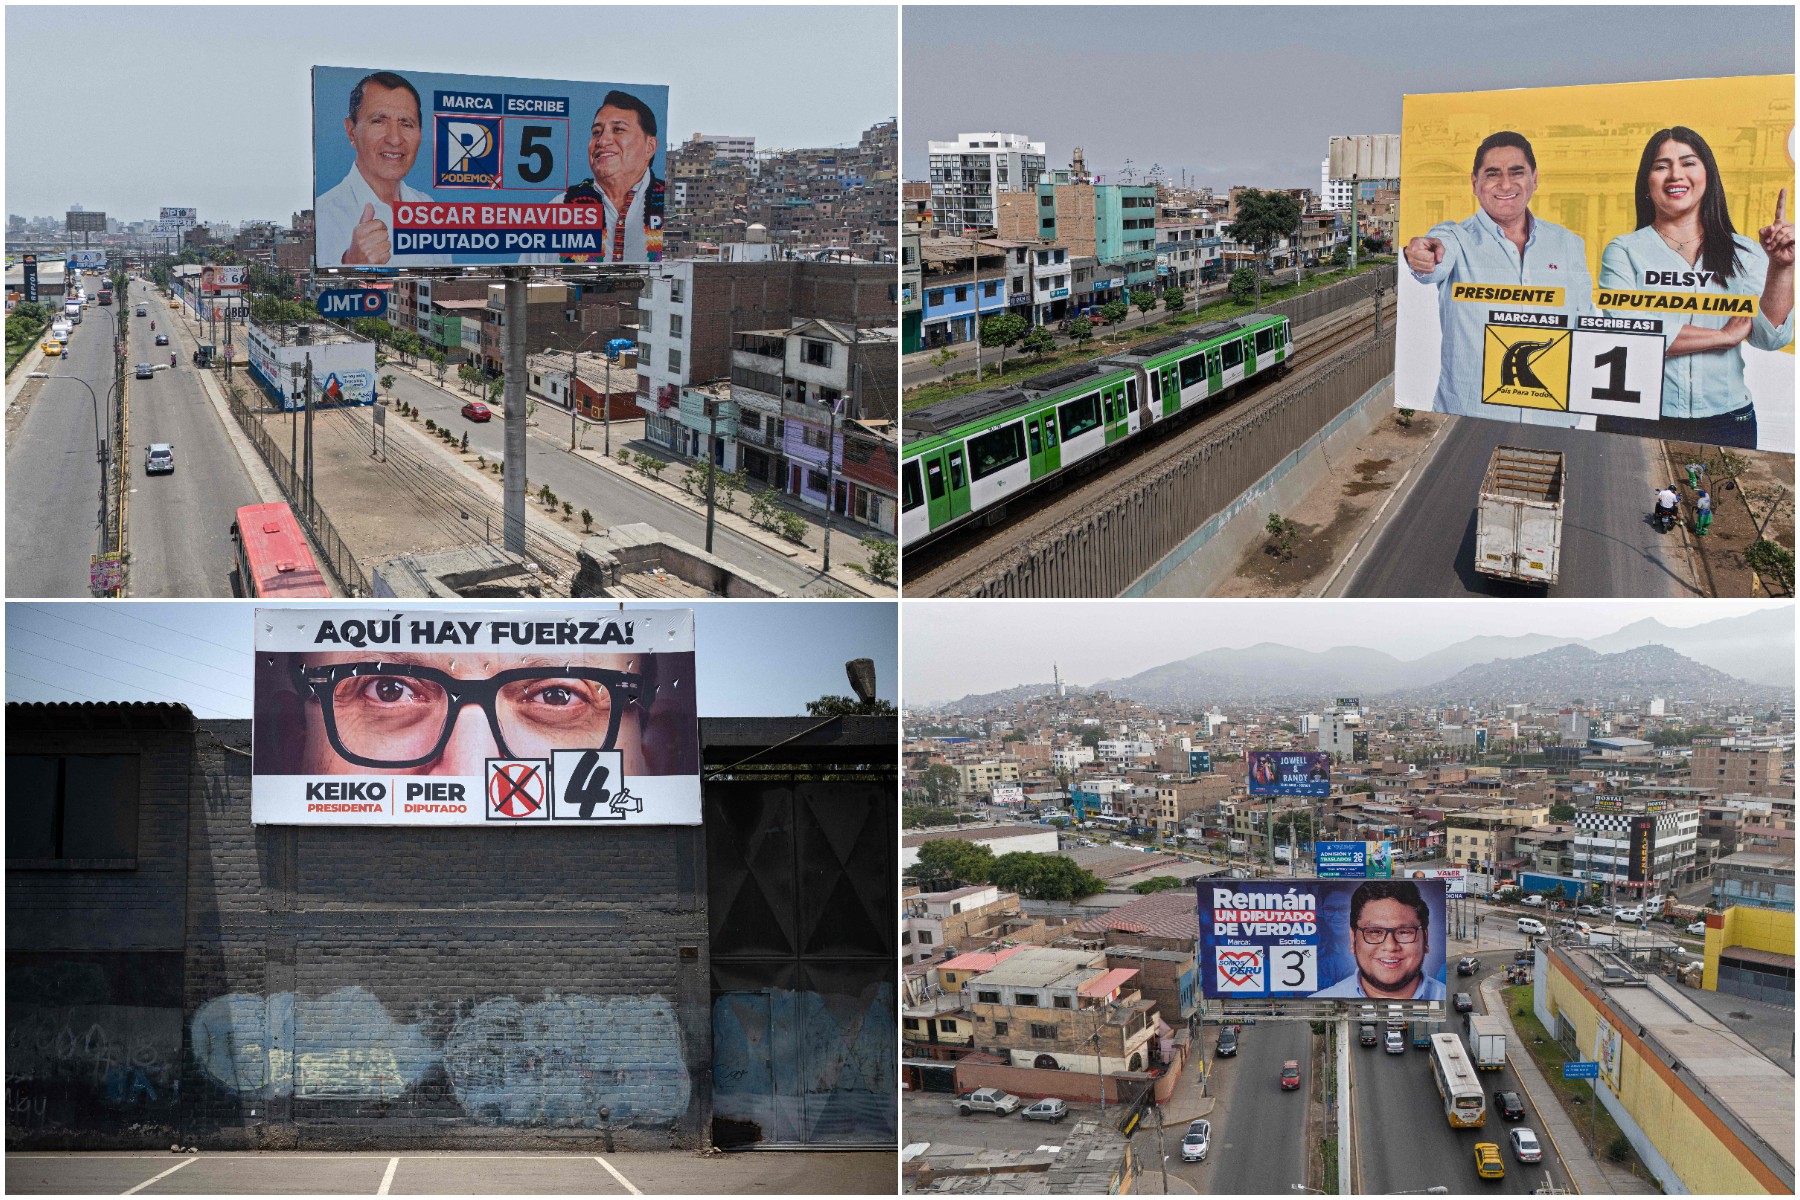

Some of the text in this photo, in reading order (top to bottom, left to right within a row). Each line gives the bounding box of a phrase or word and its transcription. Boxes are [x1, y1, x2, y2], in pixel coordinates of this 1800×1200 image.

[442, 95, 493, 109] MARCA
[508, 98, 565, 113] ESCRIBE
[517, 126, 553, 184] 5
[441, 173, 495, 184] PODEMOS
[398, 205, 597, 226] OSCAR BENAVIDES
[398, 232, 596, 250] DIPUTADO POR LIMA
[231, 274, 239, 283] 6
[1645, 271, 1712, 287] DELSY
[1454, 286, 1555, 303] PRESIDENTE
[1598, 293, 1755, 314] DIPUTADA LIMA
[1494, 312, 1559, 325] MARCA ASI
[1580, 318, 1655, 331] ESCRIBE ASI
[1590, 346, 1641, 404] 1
[314, 614, 635, 648] AQUÍ HAY FUERZA!
[1280, 756, 1308, 765] JOWELL
[1293, 765, 1299, 773] &
[563, 750, 611, 818] 4
[1283, 774, 1308, 782] RANDY
[306, 782, 387, 801] KEIKO
[406, 783, 466, 801] PIER
[307, 803, 382, 813] PRESIDENTA
[404, 804, 467, 813] DIPUTADO
[1213, 888, 1316, 910] Rennán
[1214, 910, 1315, 922] UN DIPUTADO
[1214, 922, 1317, 936] DE VERDAD
[1281, 950, 1306, 986] 3
